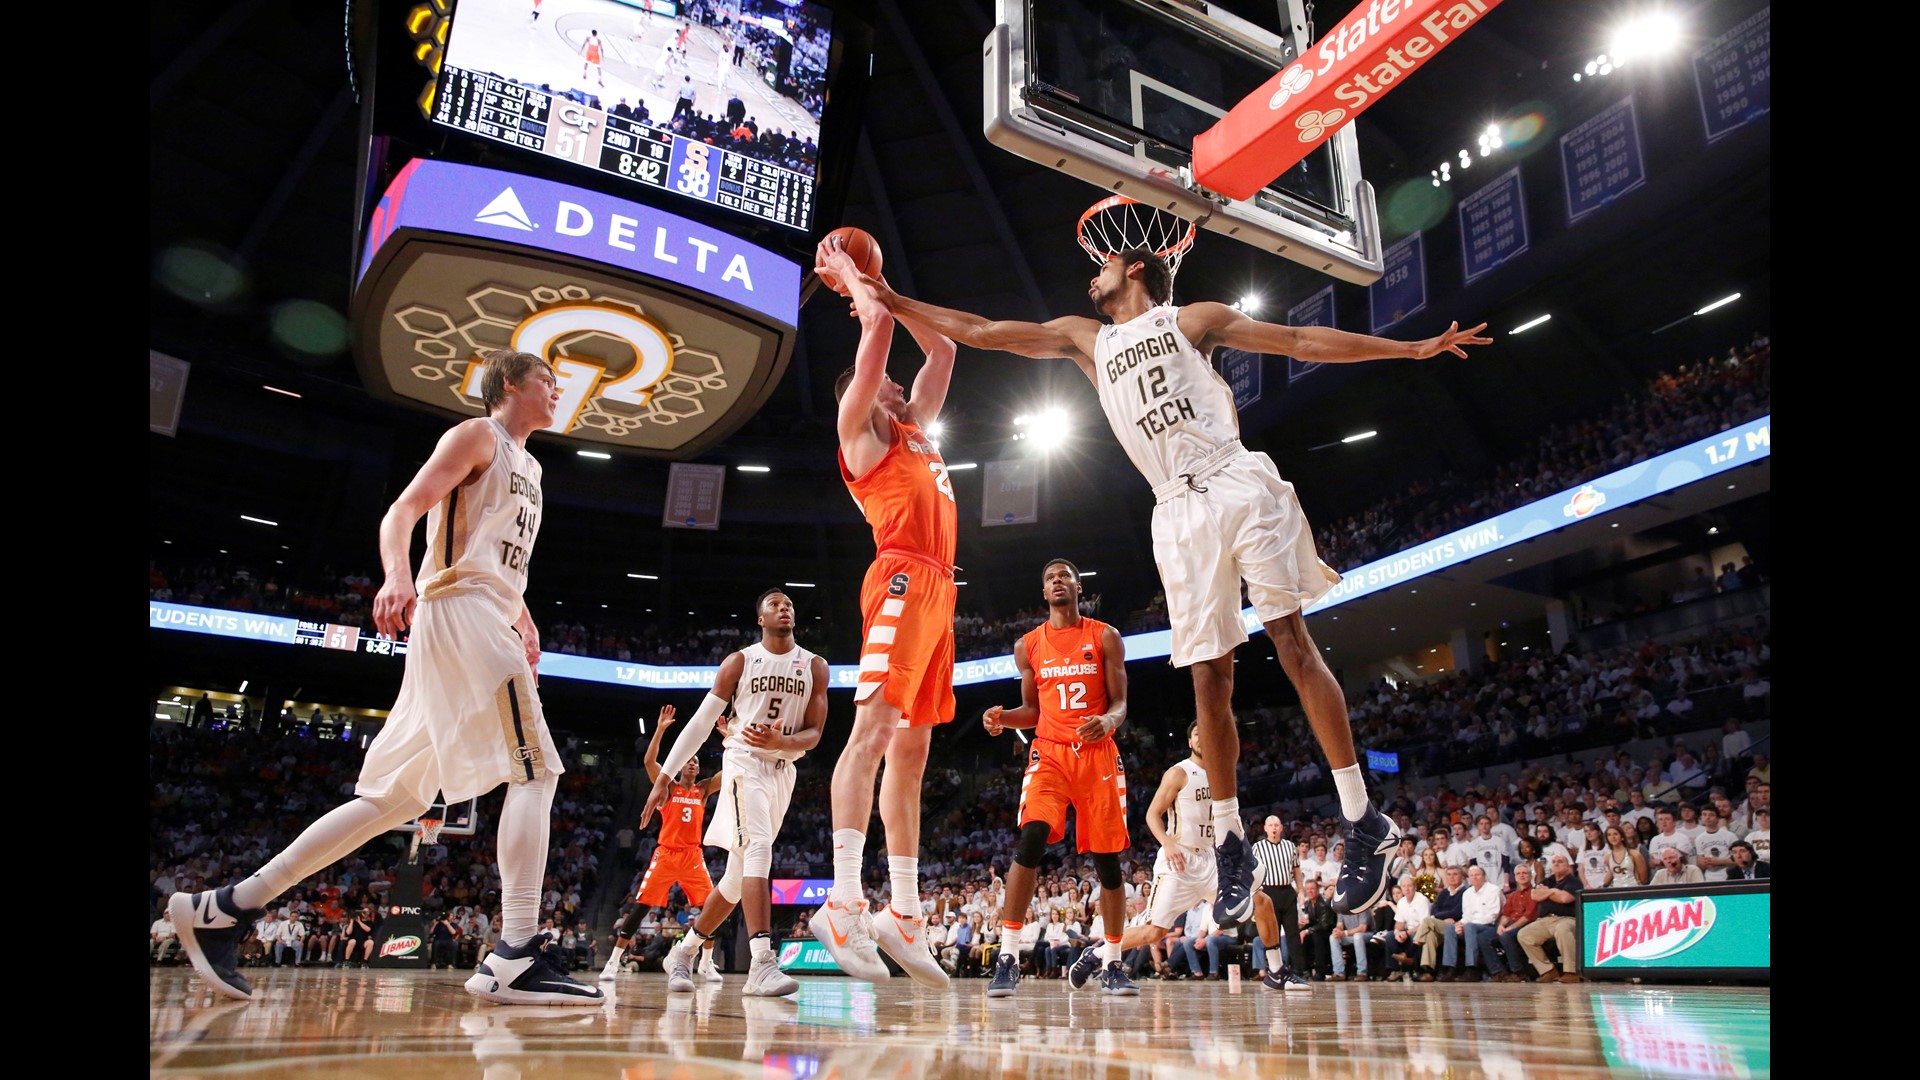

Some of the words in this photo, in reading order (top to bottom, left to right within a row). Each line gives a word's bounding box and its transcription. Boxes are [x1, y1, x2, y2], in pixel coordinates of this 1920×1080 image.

[1317, 0, 1400, 76] State
[1711, 50, 1738, 74] 1960
[1714, 67, 1741, 89] 1985
[1747, 49, 1770, 70] 199
[1334, 36, 1434, 109] State
[449, 74, 453, 83] 1
[474, 83, 484, 93] 15
[461, 88, 466, 97] 1
[489, 80, 502, 92] FG
[1717, 82, 1744, 104] 1986
[442, 93, 452, 103] 11
[1720, 97, 1748, 119] 1990
[457, 107, 461, 116] 1
[483, 109, 495, 120] FT
[530, 106, 538, 119] 4
[558, 105, 598, 133] GT
[480, 122, 499, 136] REB
[521, 120, 545, 135] BONUS
[555, 126, 587, 163] 51
[606, 132, 631, 149] 2ND
[618, 153, 660, 184] 8:42
[729, 168, 737, 179] 2
[677, 163, 711, 198] 38
[720, 181, 742, 193] BONUS
[744, 186, 755, 197] FT
[743, 201, 760, 214] REB
[555, 199, 754, 292] DELTA
[1384, 265, 1408, 289] 1938
[1106, 331, 1180, 385] GEORGIA
[1232, 360, 1249, 380] 1985
[1137, 365, 1169, 404] 12
[1232, 376, 1249, 394] 1996
[1136, 397, 1196, 440] TECH
[1704, 437, 1739, 464] 1.7
[1745, 425, 1770, 452] M
[928, 461, 956, 503] 2
[516, 506, 536, 543] 44
[1331, 574, 1365, 598] OUR
[1368, 542, 1455, 585] STUDENTS
[1458, 525, 1504, 553] WIN.
[888, 573, 909, 597] S
[244, 618, 289, 638] WIN.
[330, 633, 347, 649] 51
[366, 640, 391, 655] 8:42
[616, 667, 636, 681] 1.7
[638, 669, 700, 684] MILLION
[1040, 664, 1098, 679] SYRACUSE
[751, 675, 805, 697] GEORGIA
[1056, 681, 1088, 710] 12
[767, 698, 782, 719] 5
[513, 746, 539, 761] GT
[672, 796, 701, 806] SYRACUSE
[681, 806, 693, 823] 3
[401, 906, 421, 915] PNC
[1596, 899, 1704, 965] LIBMAN
[380, 939, 418, 956] LIBMAN
